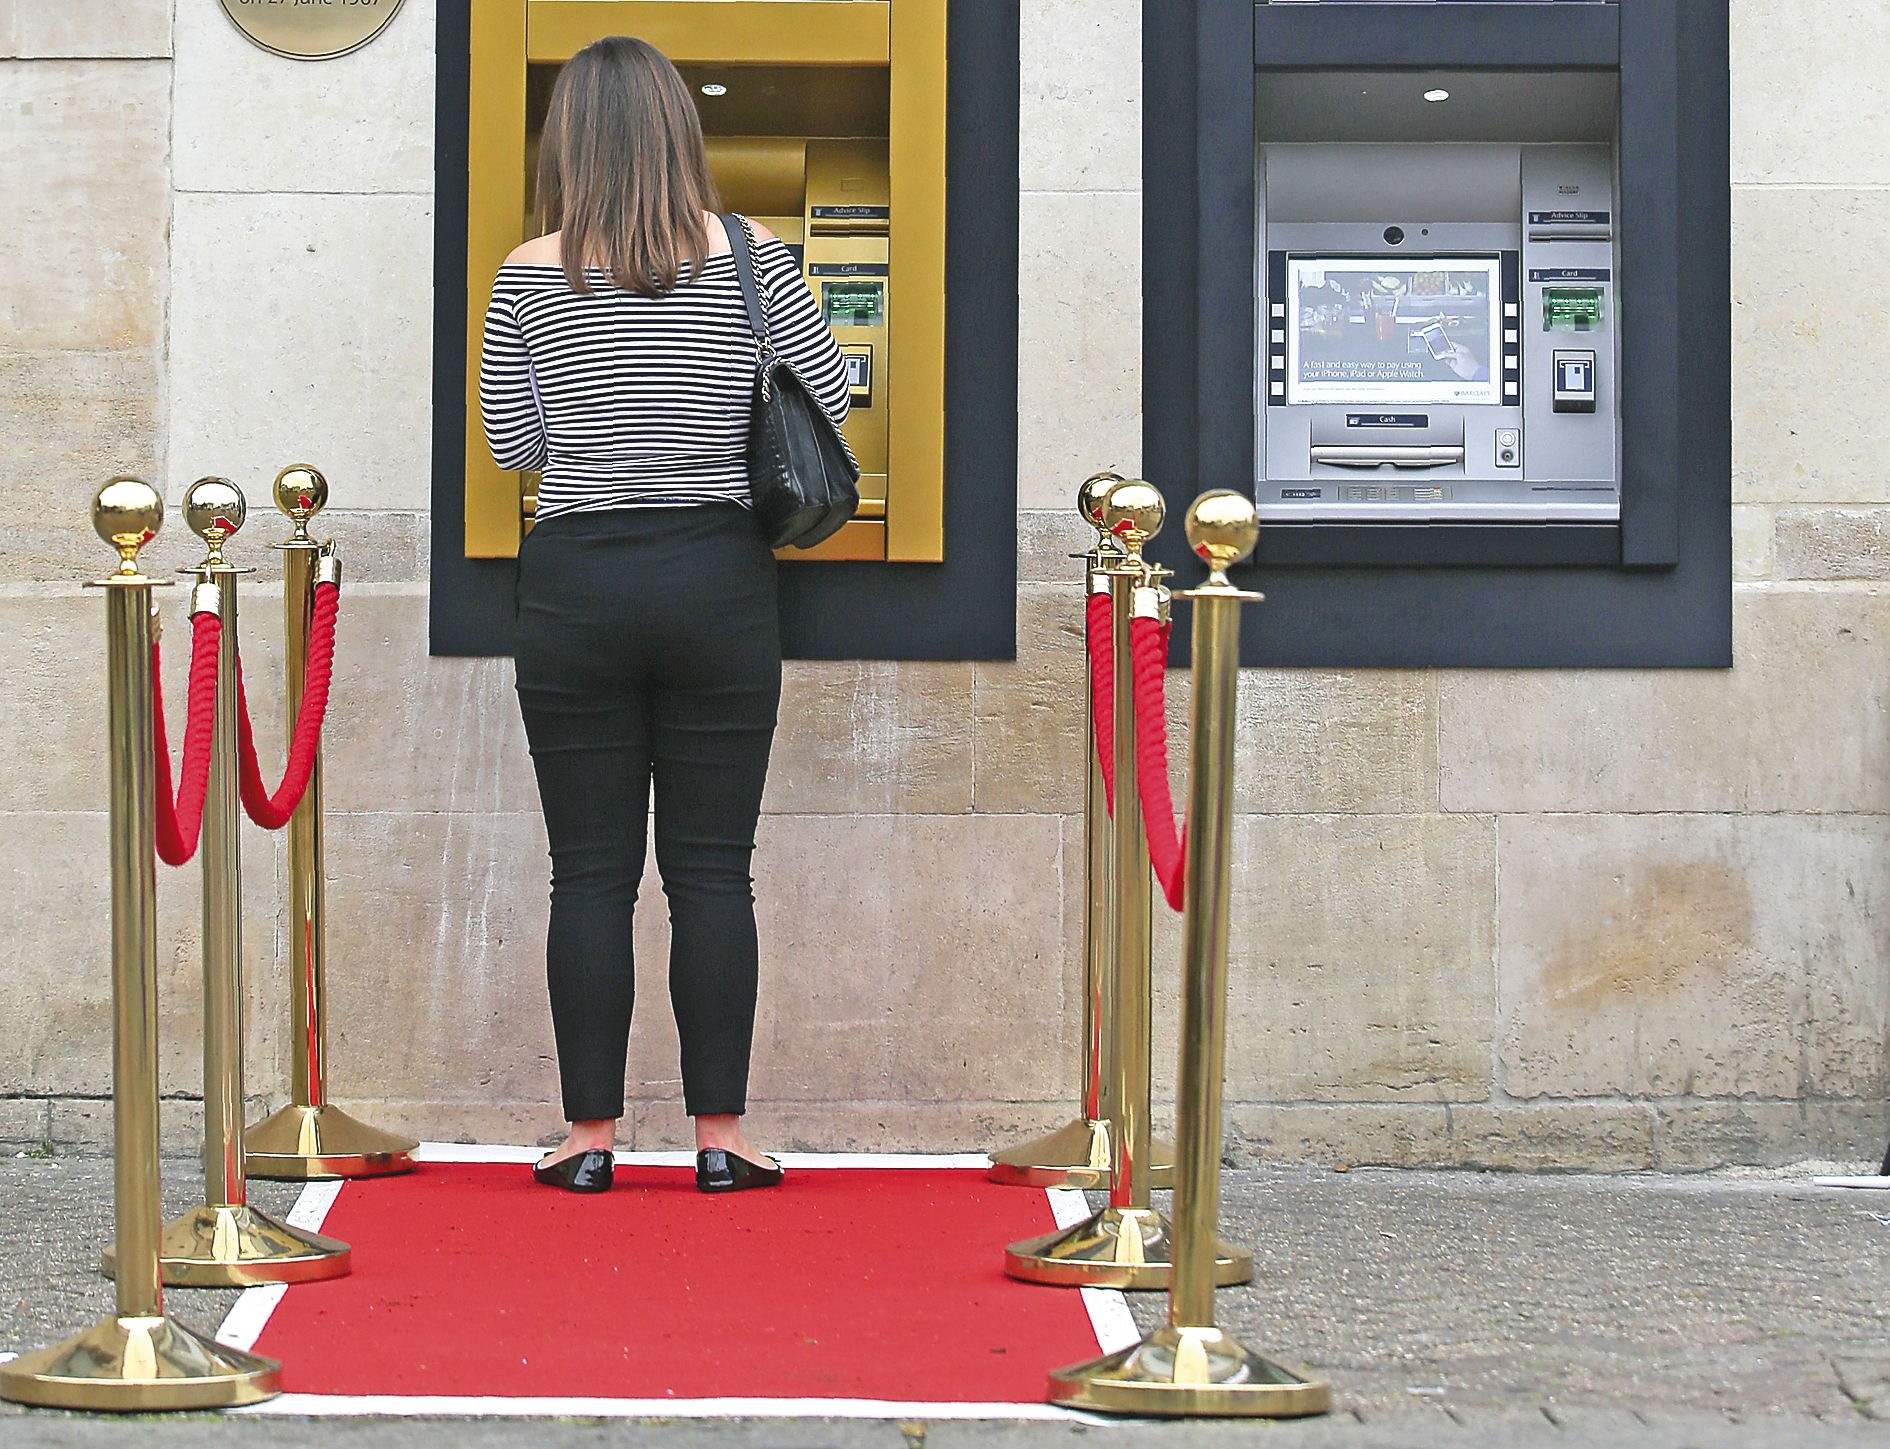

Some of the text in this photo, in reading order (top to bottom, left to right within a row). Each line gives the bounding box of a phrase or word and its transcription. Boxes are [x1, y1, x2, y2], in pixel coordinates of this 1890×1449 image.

[1402, 362, 1421, 370] using
[1303, 371, 1320, 379] your
[1377, 370, 1398, 379] Apple
